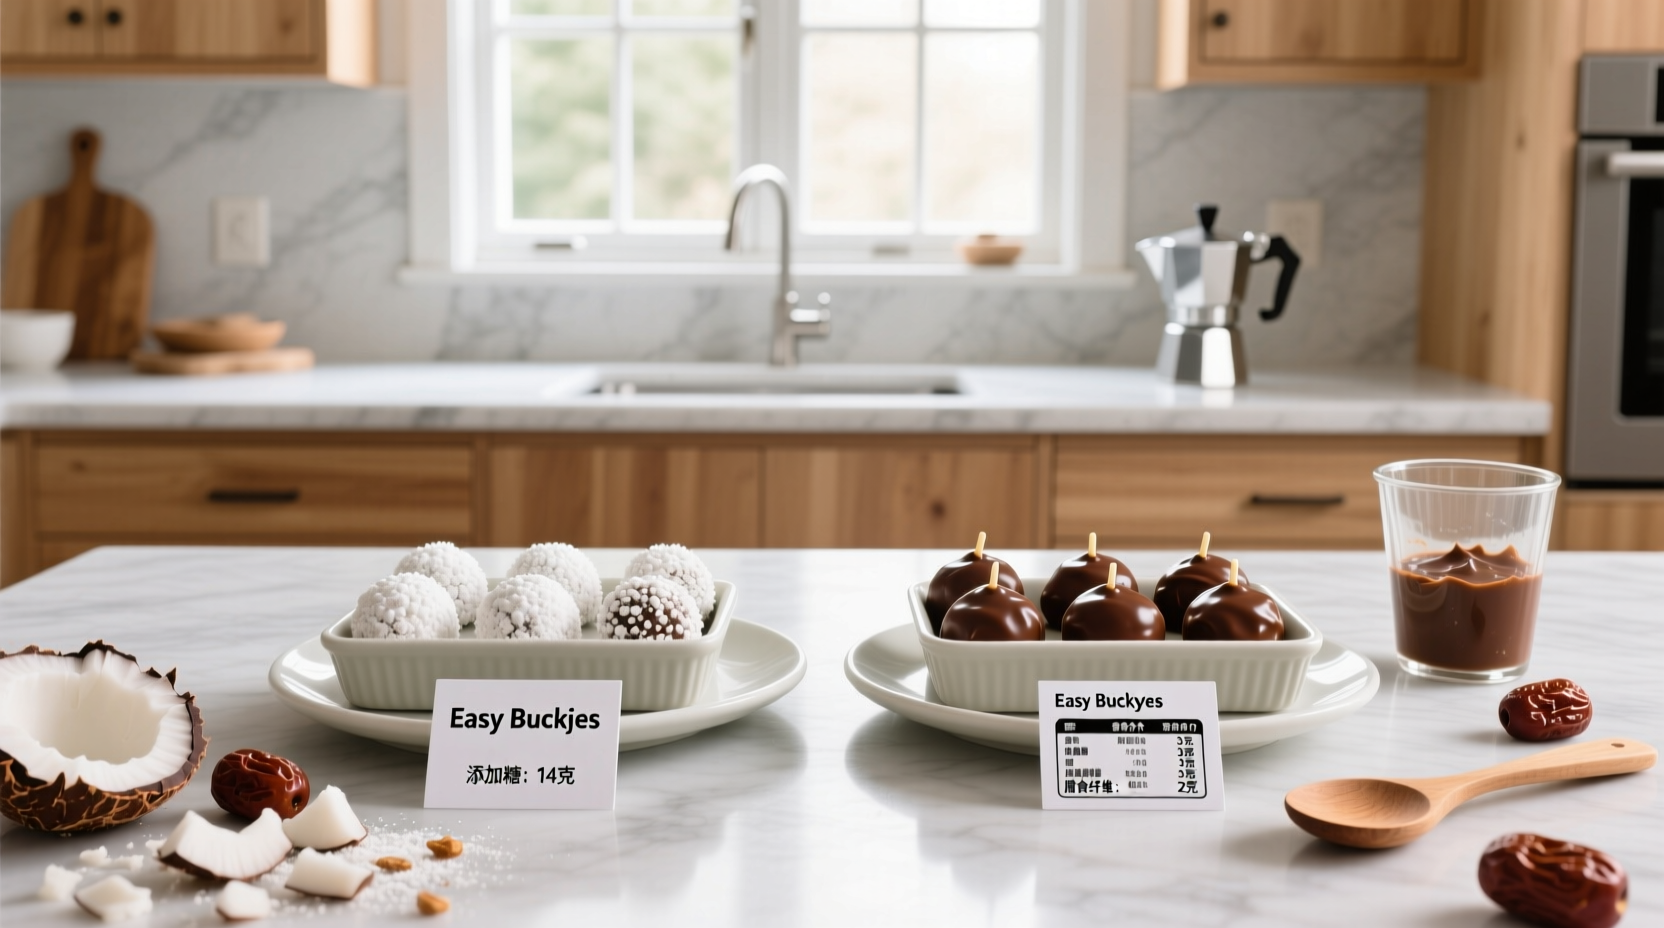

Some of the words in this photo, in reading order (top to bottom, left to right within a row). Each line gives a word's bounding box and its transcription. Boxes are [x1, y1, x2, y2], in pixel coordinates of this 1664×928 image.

[1055, 693, 1091, 711] Easy
[1096, 692, 1164, 712] Buckyes
[450, 707, 505, 735] Easy
[511, 707, 600, 735] Buckjes
